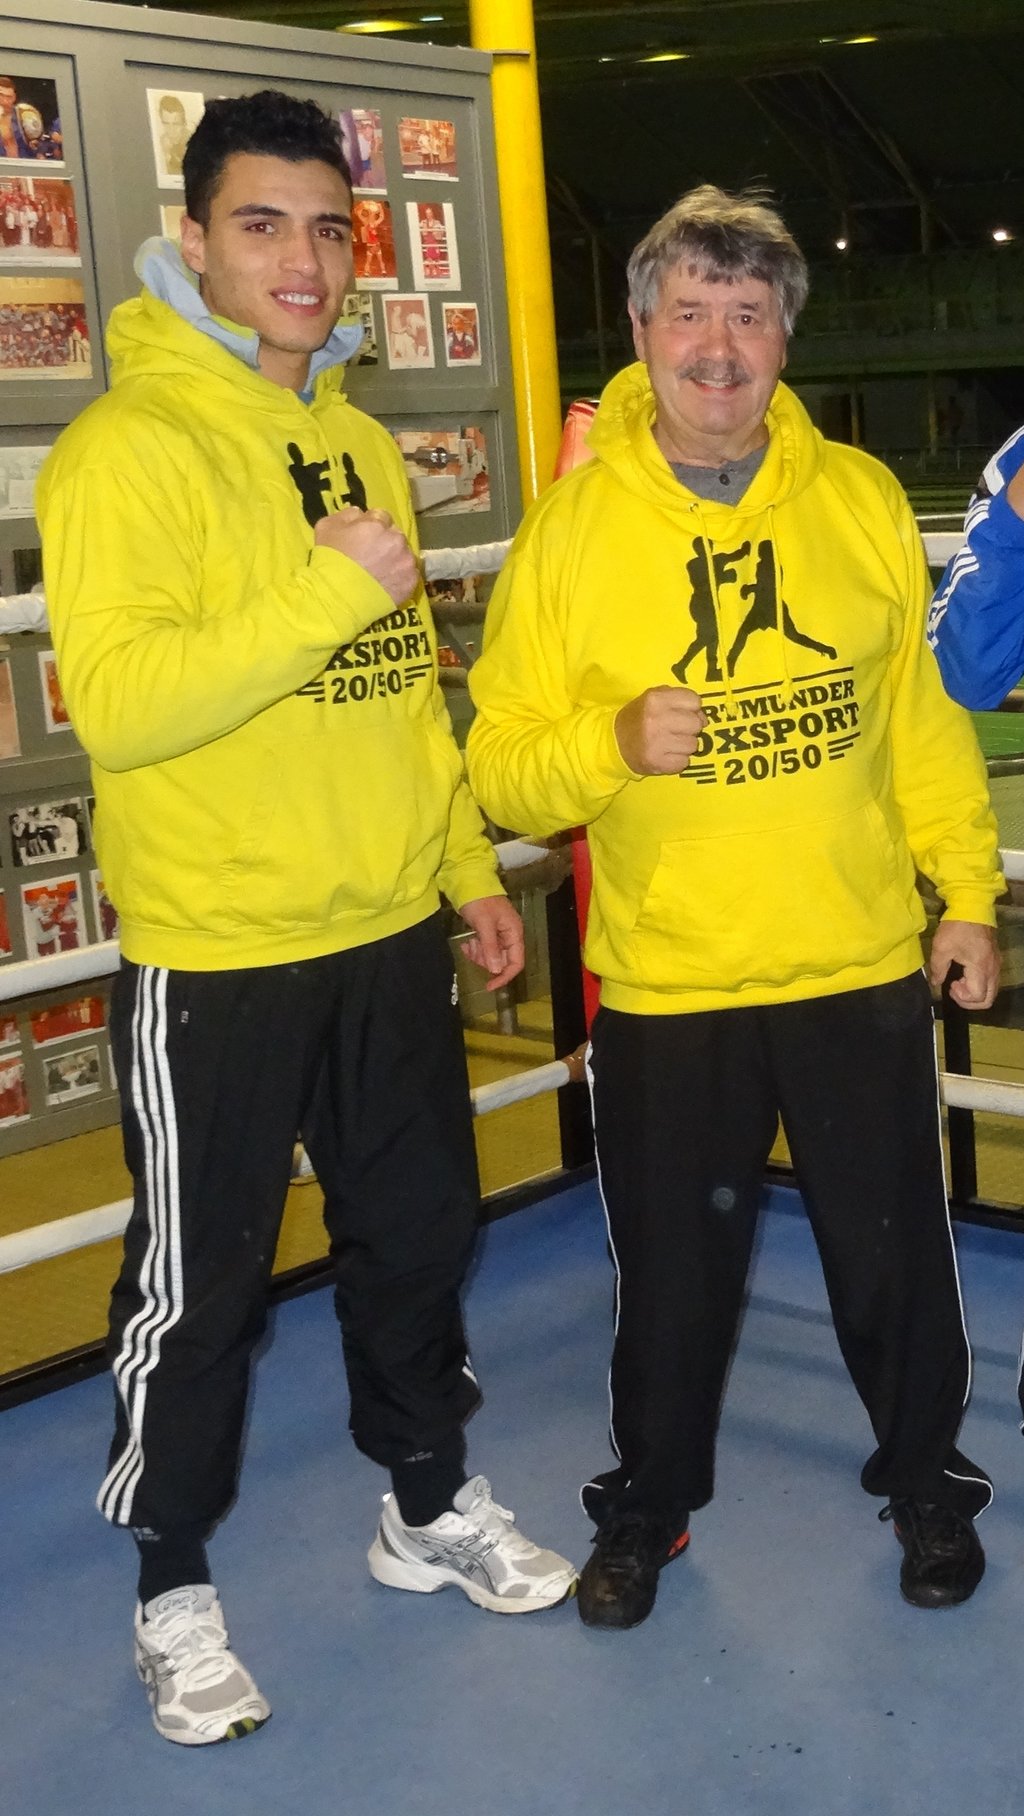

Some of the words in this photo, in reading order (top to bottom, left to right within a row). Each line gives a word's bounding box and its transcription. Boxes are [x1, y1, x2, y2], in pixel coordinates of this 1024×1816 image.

[325, 631, 433, 672] XSPORT
[330, 669, 403, 705] 20/50
[701, 679, 855, 724] RTMUNDER
[692, 701, 860, 758] OXSPORT
[723, 744, 823, 786] 20/50
